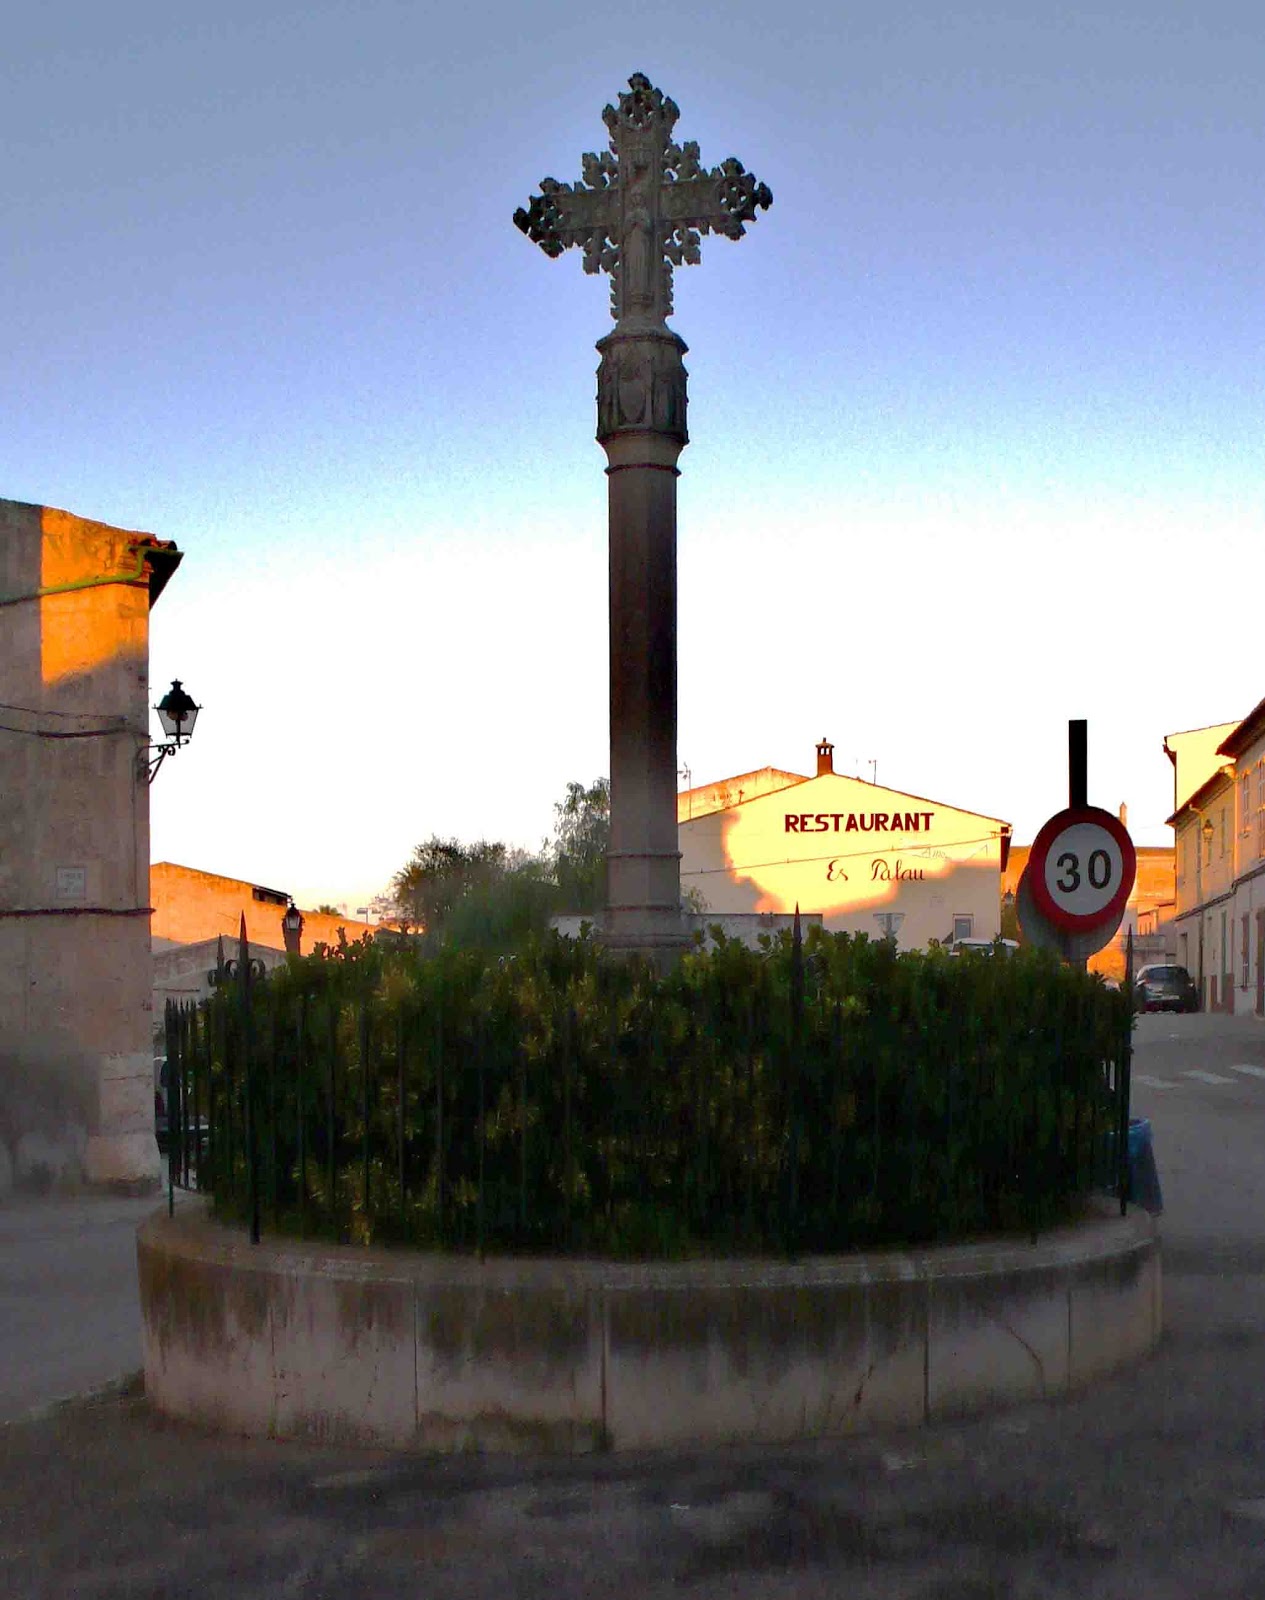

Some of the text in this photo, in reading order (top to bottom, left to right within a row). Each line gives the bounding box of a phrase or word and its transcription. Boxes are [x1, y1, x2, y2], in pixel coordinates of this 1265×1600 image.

[784, 812, 935, 833] RESTAURANT
[825, 858, 926, 882] Es Palau
[1056, 849, 1112, 893] 30
